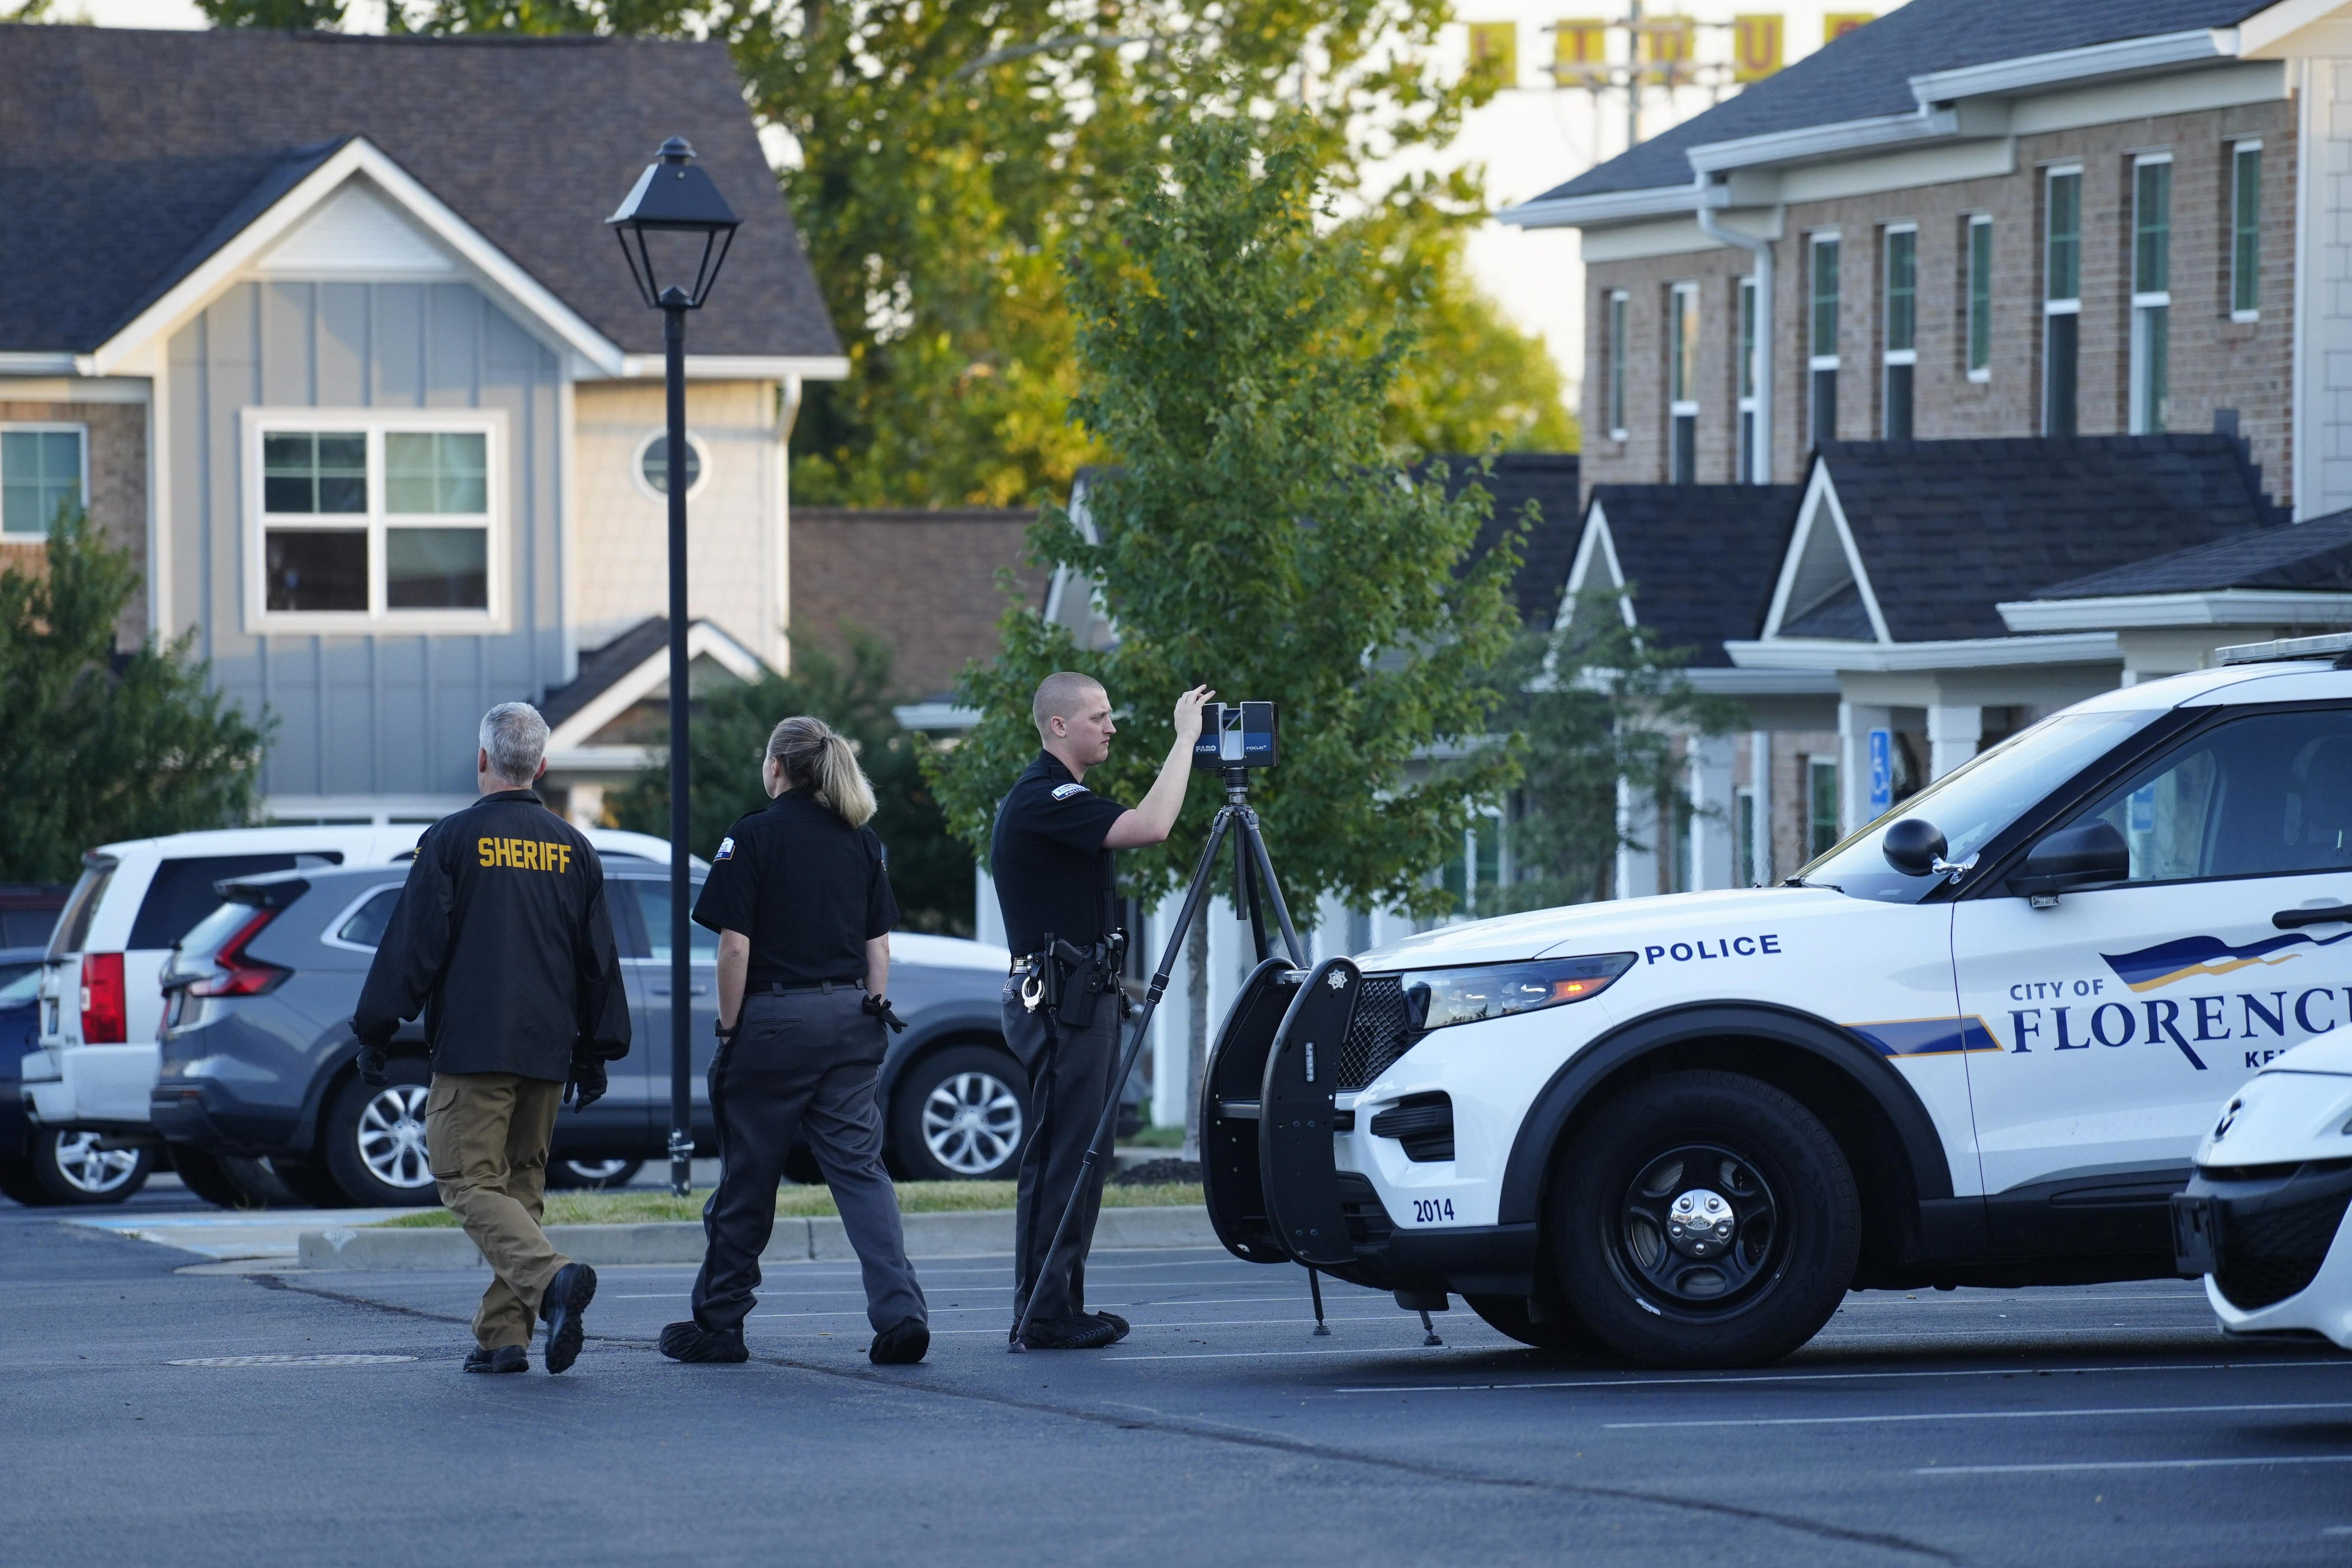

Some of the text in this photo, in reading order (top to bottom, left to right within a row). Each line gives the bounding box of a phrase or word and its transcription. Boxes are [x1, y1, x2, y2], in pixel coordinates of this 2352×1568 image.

[478, 837, 571, 873] SHERIFF
[1645, 934, 1782, 965] POLICE
[2010, 979, 2103, 1001] CITY OF
[1413, 1198, 1454, 1222] 2014
